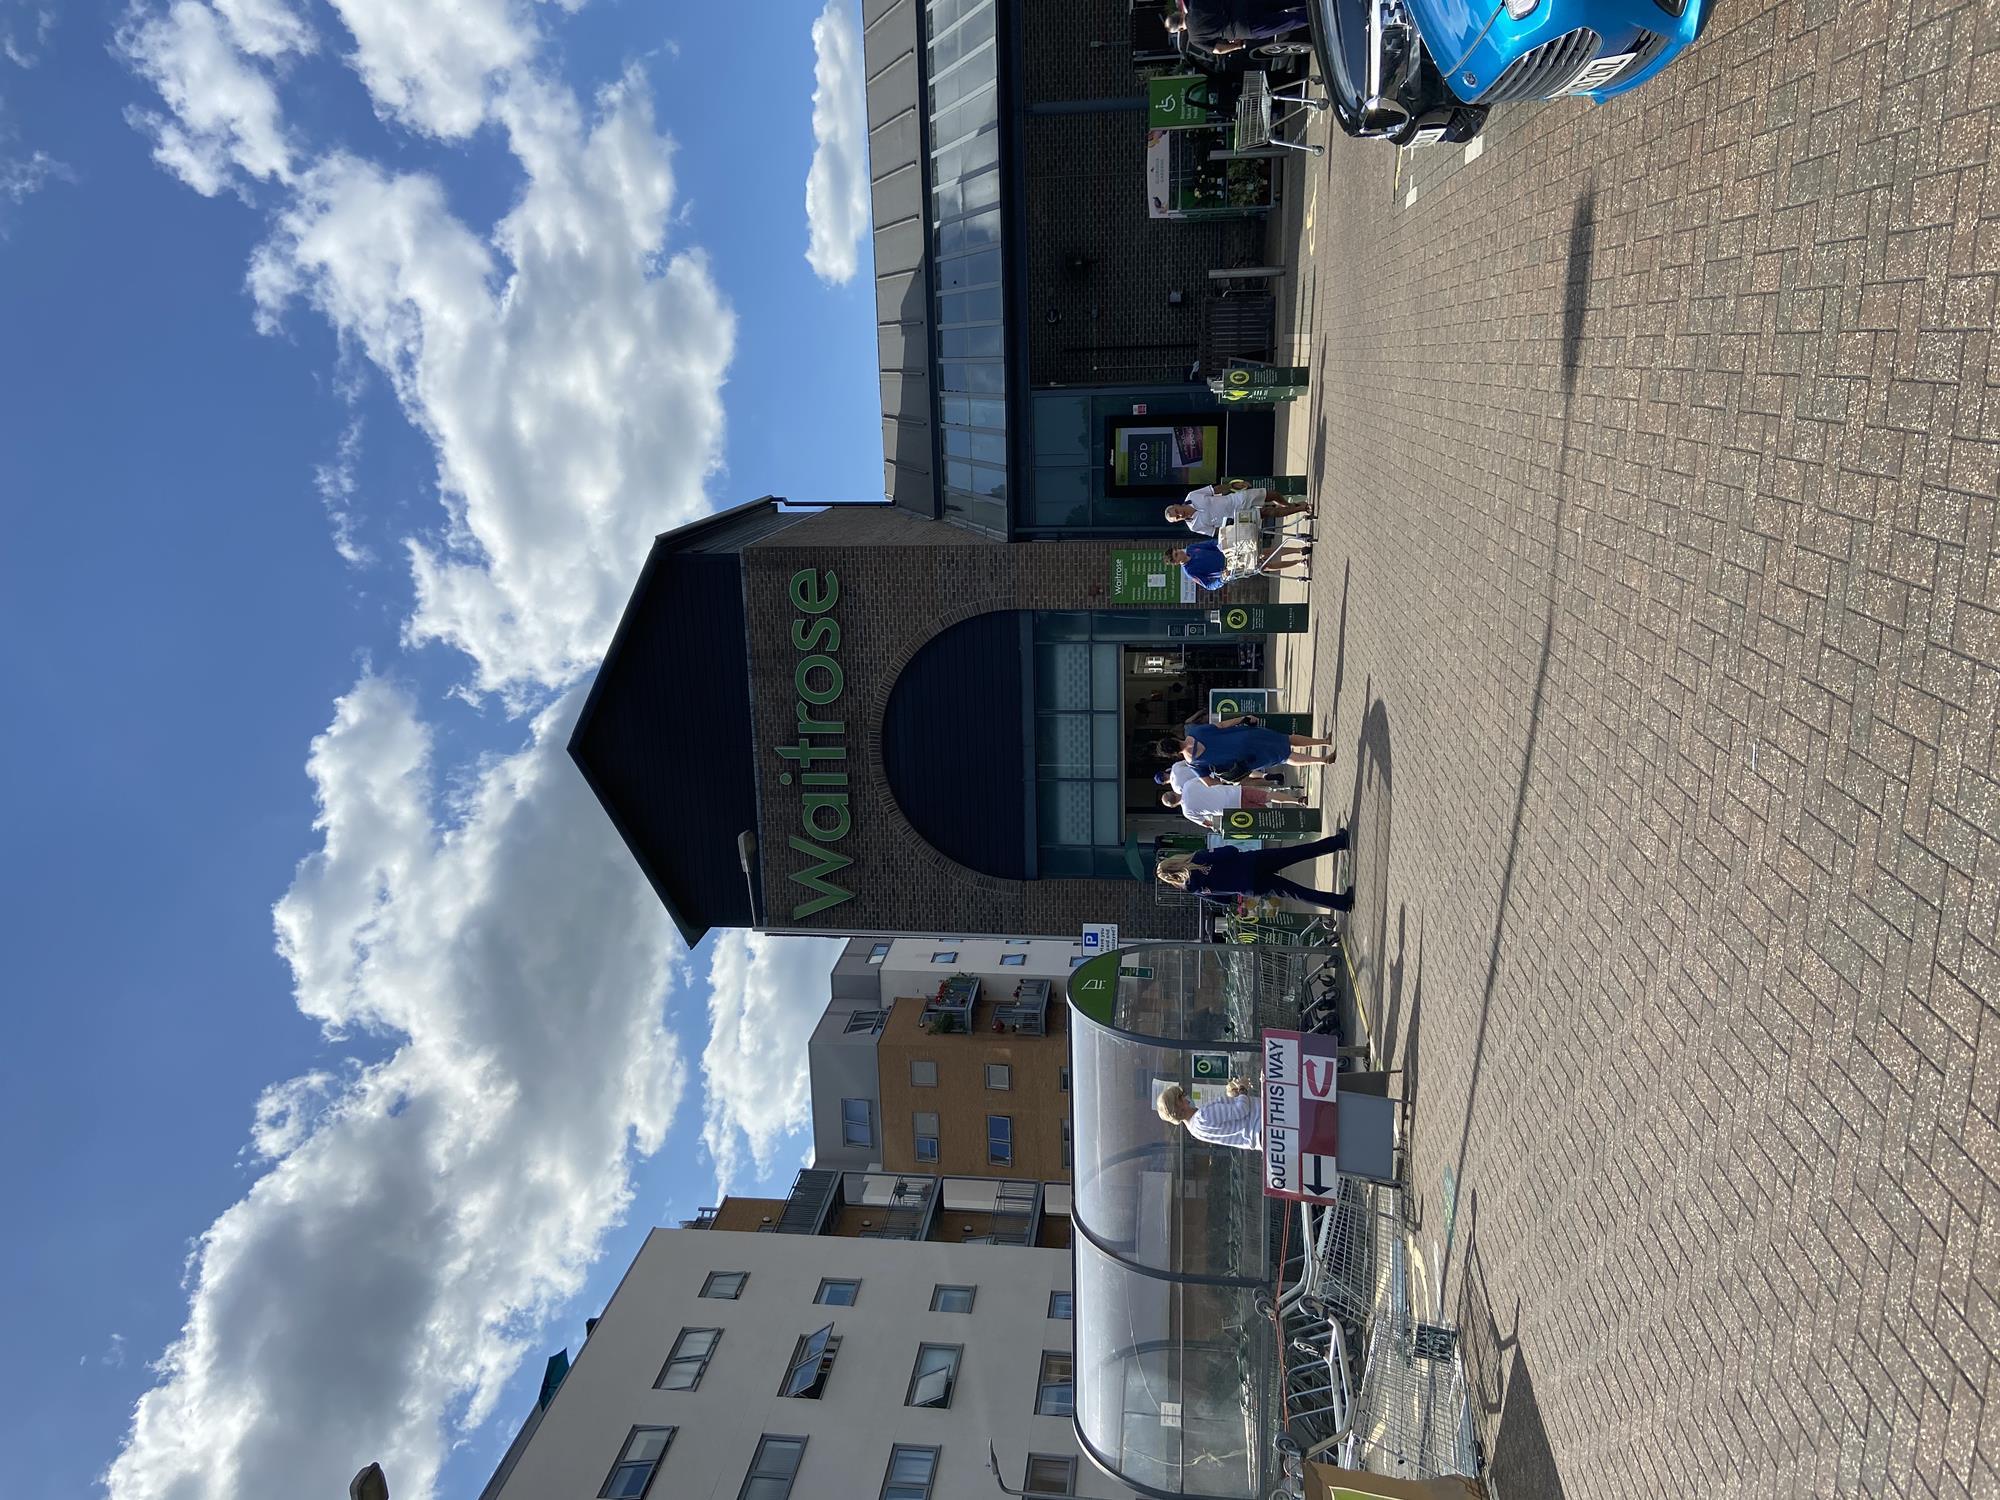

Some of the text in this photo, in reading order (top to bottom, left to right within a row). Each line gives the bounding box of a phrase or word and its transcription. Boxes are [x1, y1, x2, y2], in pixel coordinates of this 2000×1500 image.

[1139, 443, 1148, 477] FOOD
[1114, 558, 1122, 595] Waitrose
[774, 568, 856, 920] Waitrose
[1086, 936, 1097, 944] P
[1269, 1040, 1286, 1190] QUEUE THIS WAY
